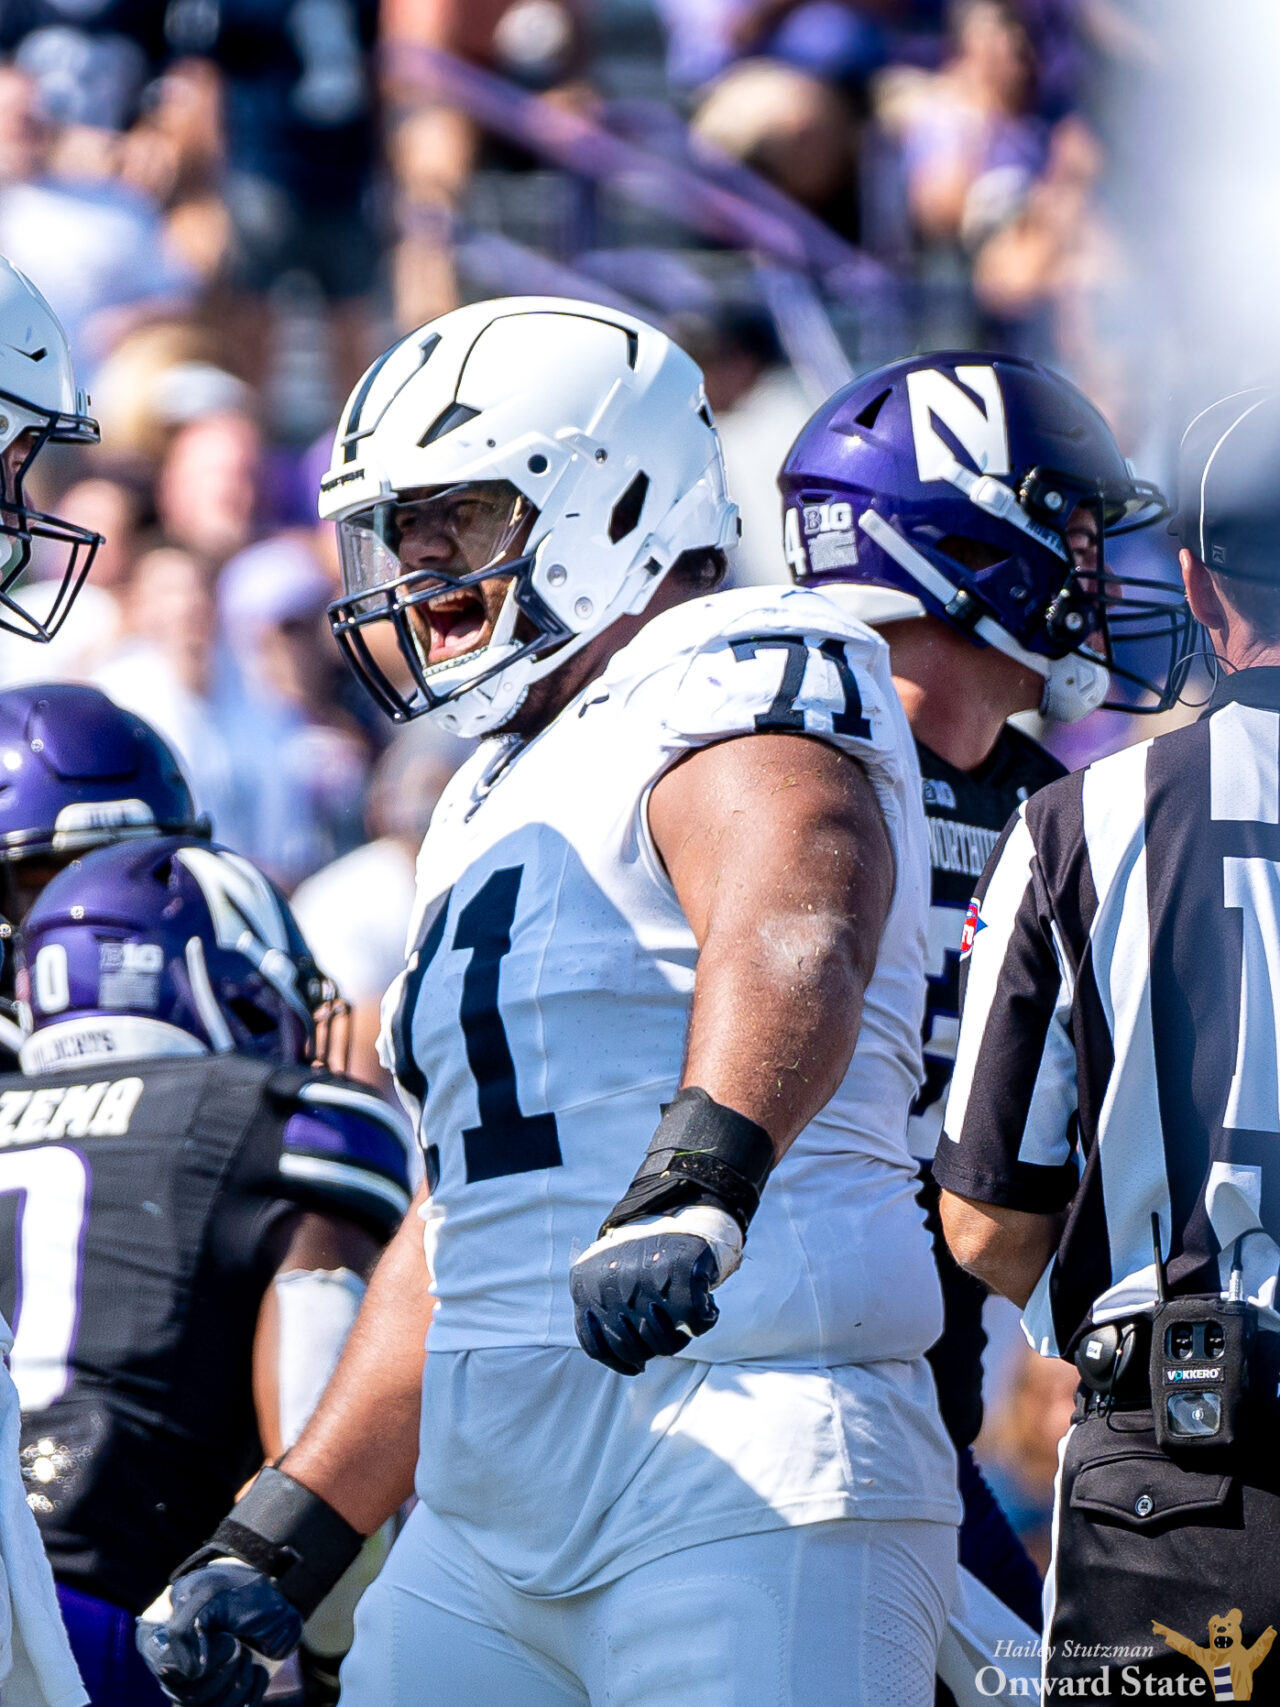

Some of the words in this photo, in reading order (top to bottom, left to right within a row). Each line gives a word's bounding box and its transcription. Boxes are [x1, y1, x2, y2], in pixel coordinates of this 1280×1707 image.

[906, 365, 1011, 482] N
[728, 635, 873, 740] 71
[35, 943, 70, 1014] 0
[1167, 1368, 1219, 1381] VOKKERO
